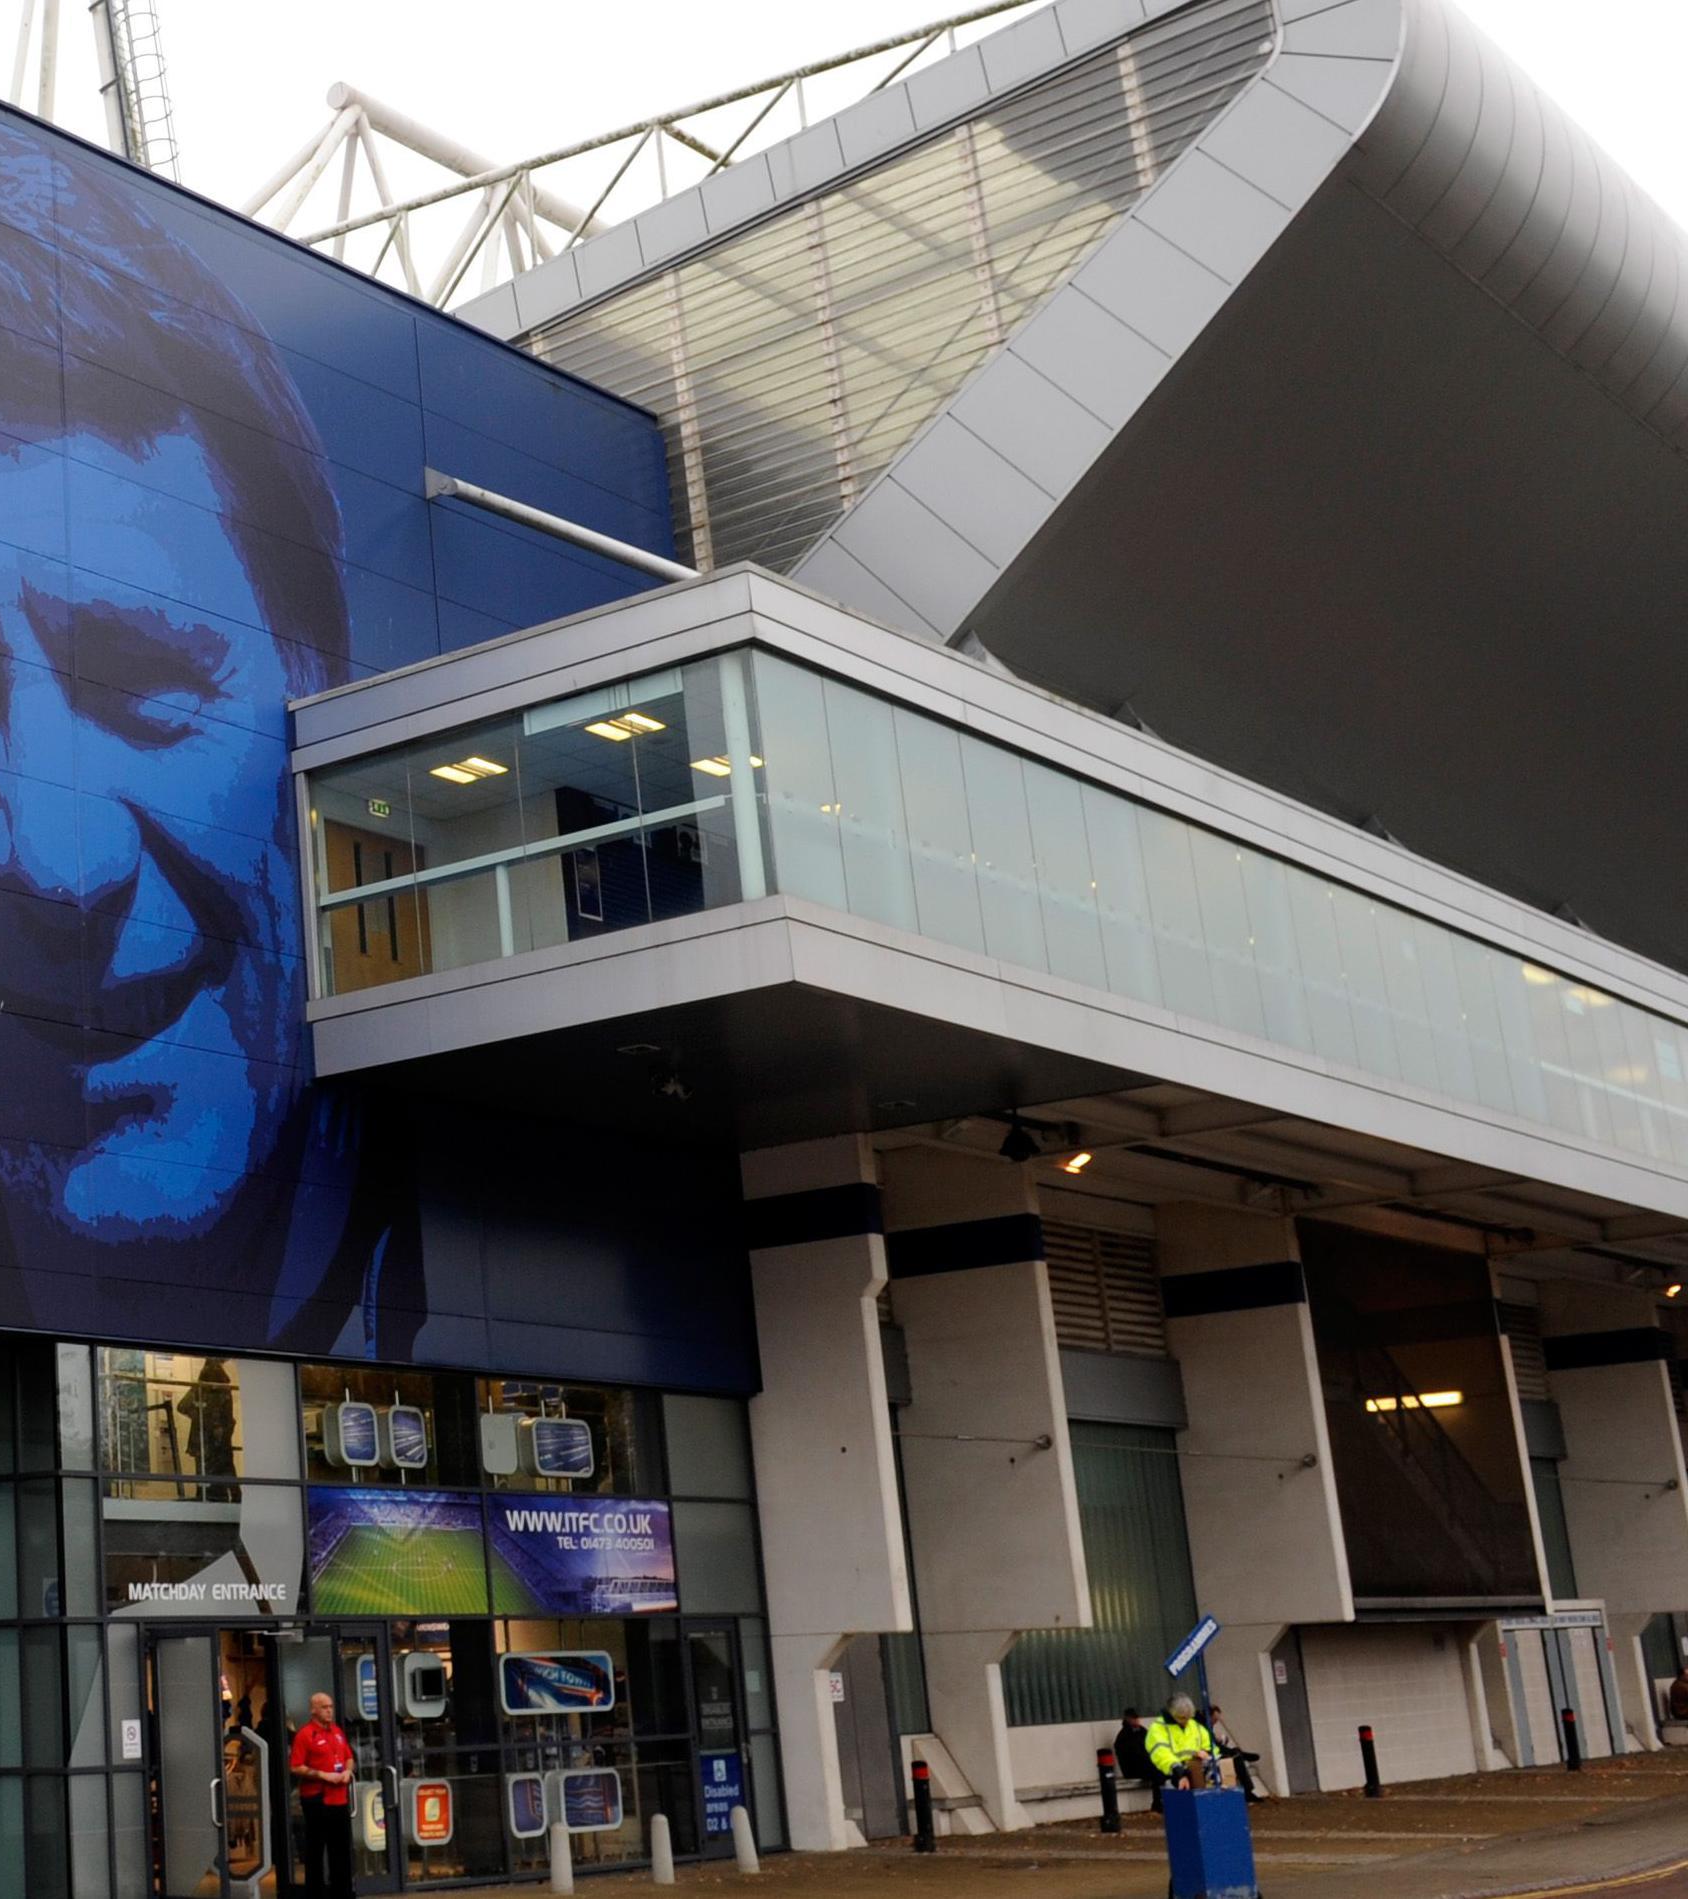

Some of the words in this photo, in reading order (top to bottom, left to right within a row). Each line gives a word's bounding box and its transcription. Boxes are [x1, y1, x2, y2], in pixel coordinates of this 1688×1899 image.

[505, 1510, 652, 1534] WWW.ITFC.CO.UK
[557, 1537, 578, 1549] TEL:
[581, 1537, 612, 1550] 01473
[615, 1538, 655, 1550] 400501
[128, 1582, 206, 1600] MATCHDAY
[212, 1583, 286, 1600] ENTRANCE
[704, 1785, 740, 1798] Disabled
[706, 1802, 729, 1814] areas
